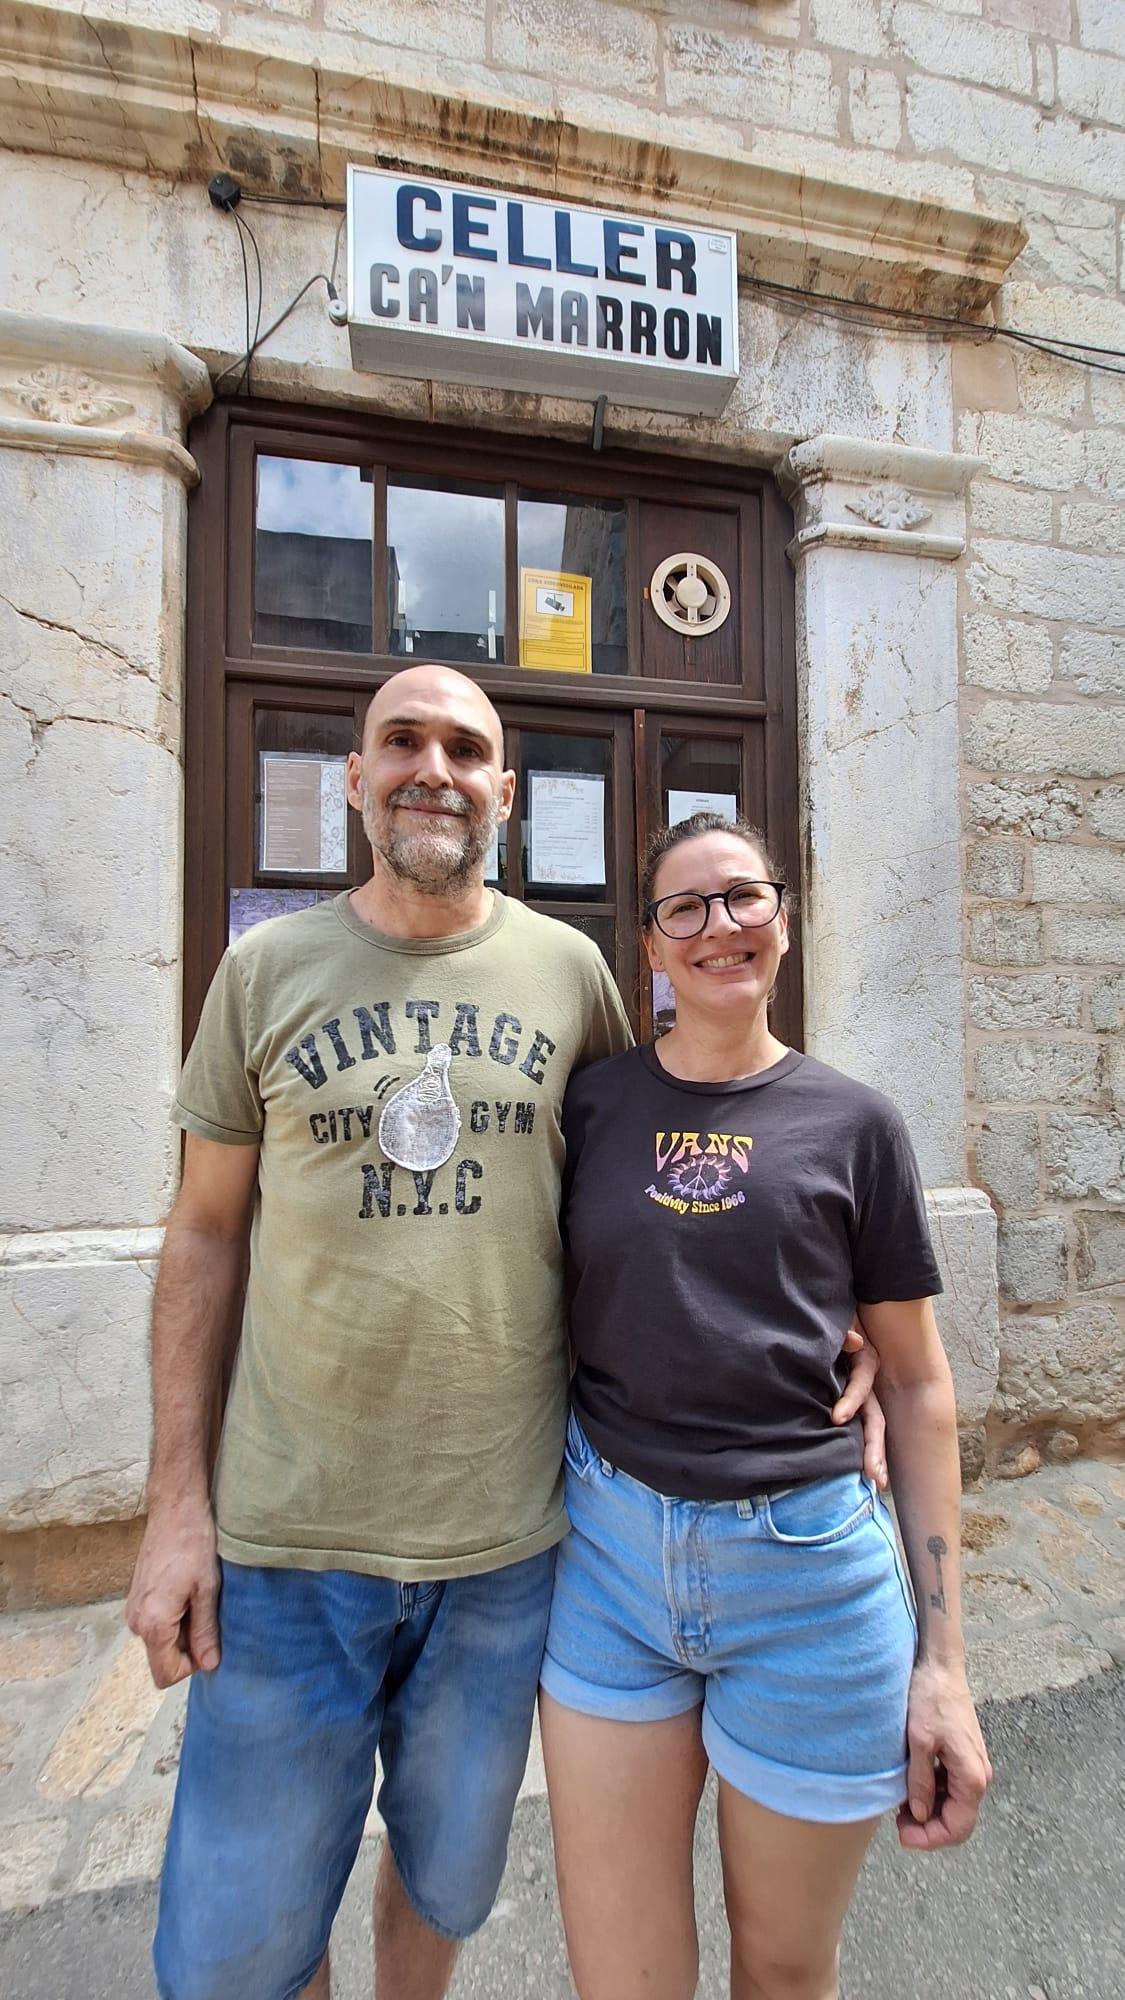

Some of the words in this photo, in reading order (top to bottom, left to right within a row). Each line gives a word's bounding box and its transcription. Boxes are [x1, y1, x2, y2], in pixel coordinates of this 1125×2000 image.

[396, 184, 698, 296] CELLER
[369, 263, 487, 331] CA'N
[515, 282, 723, 366] MARRON
[285, 1000, 556, 1090] VINTAGE
[309, 1105, 373, 1144] CITY
[470, 1100, 536, 1134] GYM
[656, 1132, 753, 1173] VANS
[358, 1159, 483, 1219] N.Y.C
[644, 1184, 690, 1215] Positivity
[691, 1201, 721, 1213] Since
[721, 1190, 746, 1211] 1966
